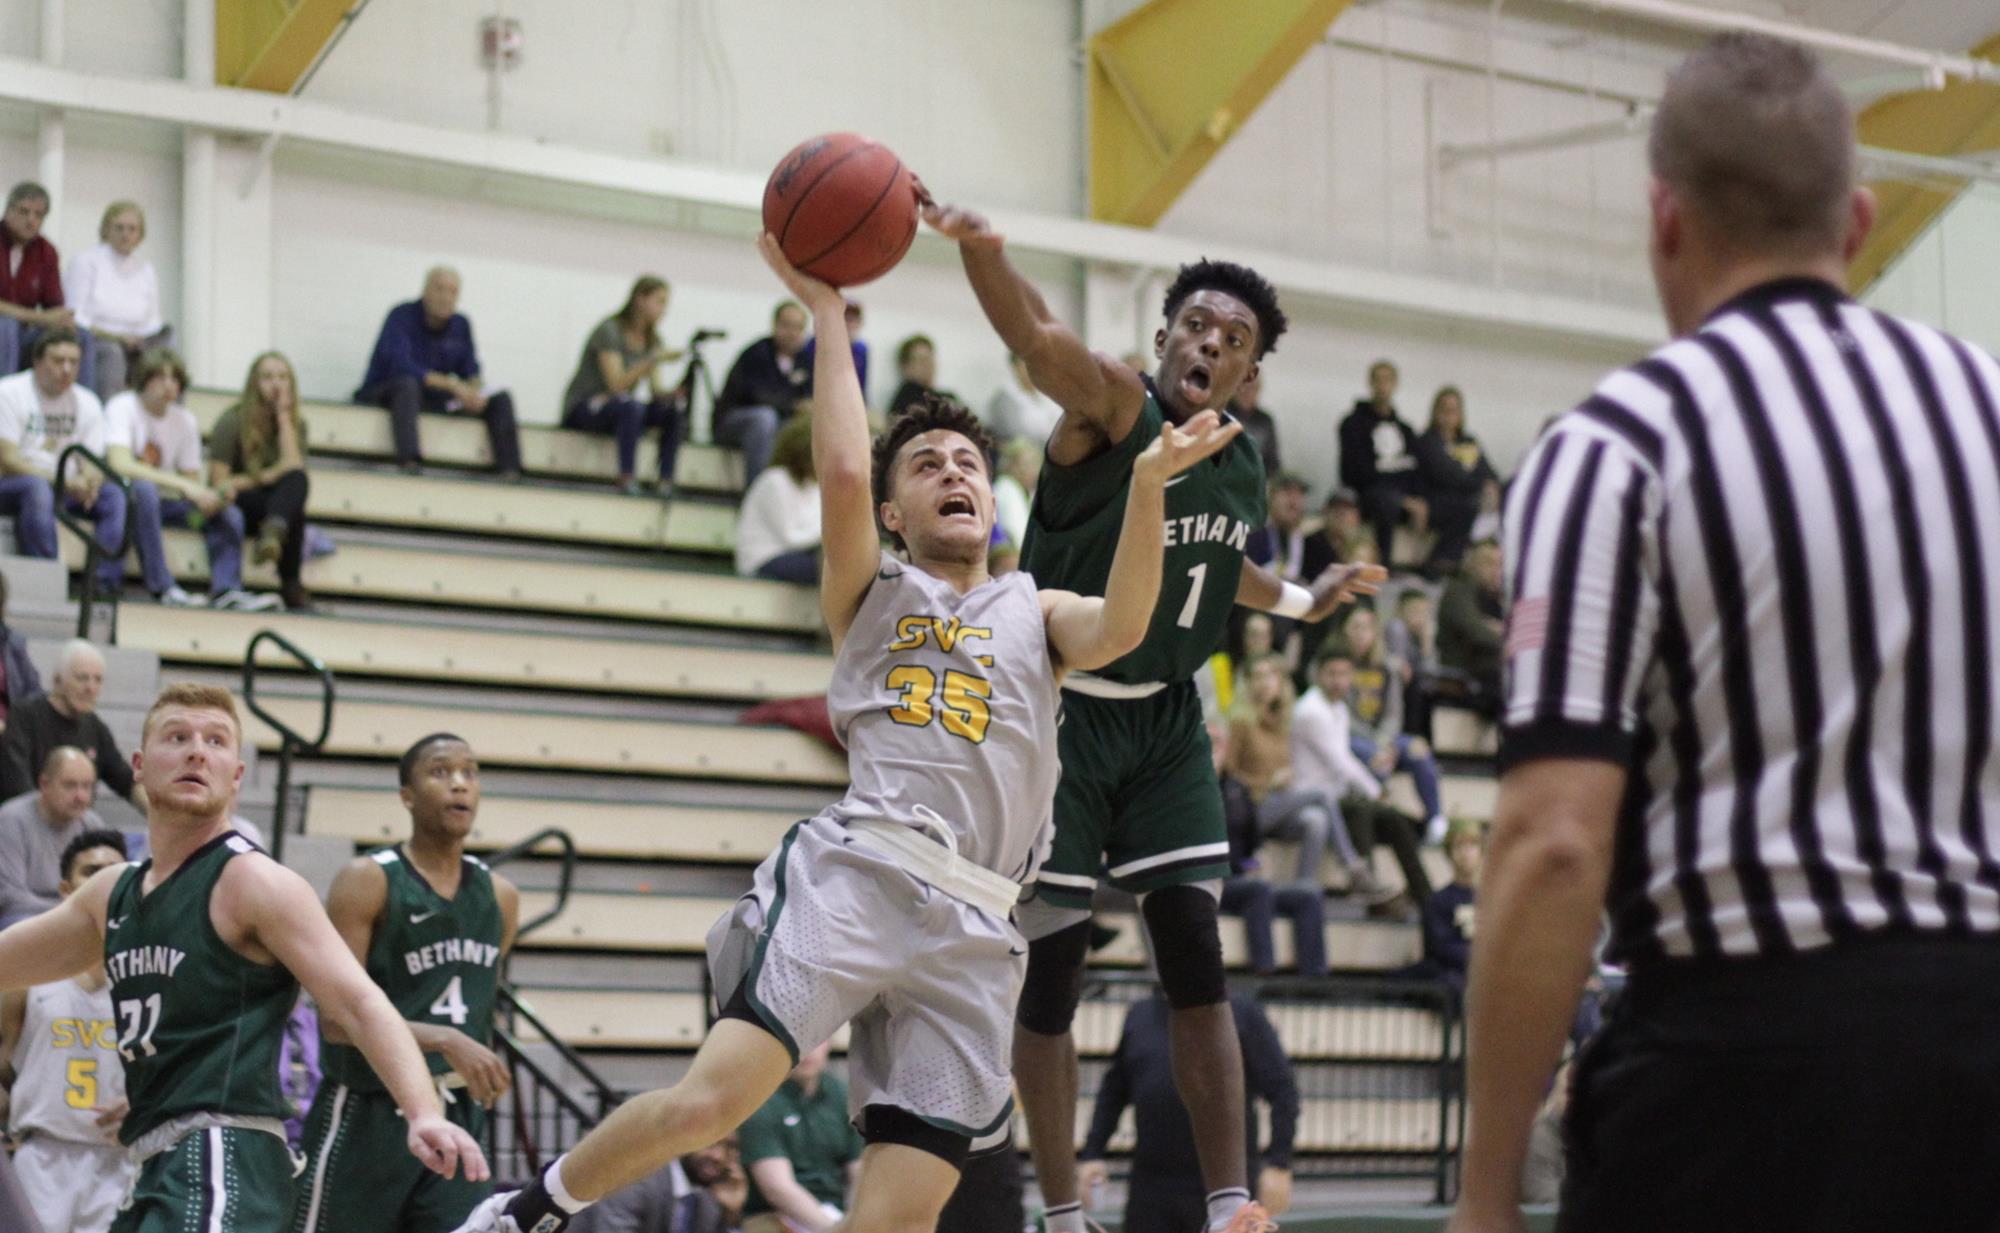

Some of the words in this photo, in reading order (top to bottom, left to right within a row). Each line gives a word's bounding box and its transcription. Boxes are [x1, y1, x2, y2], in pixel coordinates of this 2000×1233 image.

[1164, 513, 1250, 551] ETHAN
[1177, 563, 1207, 629] 1
[888, 615, 994, 668] SVC
[885, 664, 992, 745] 35
[430, 976, 469, 1024] 4
[64, 1058, 100, 1110] 5
